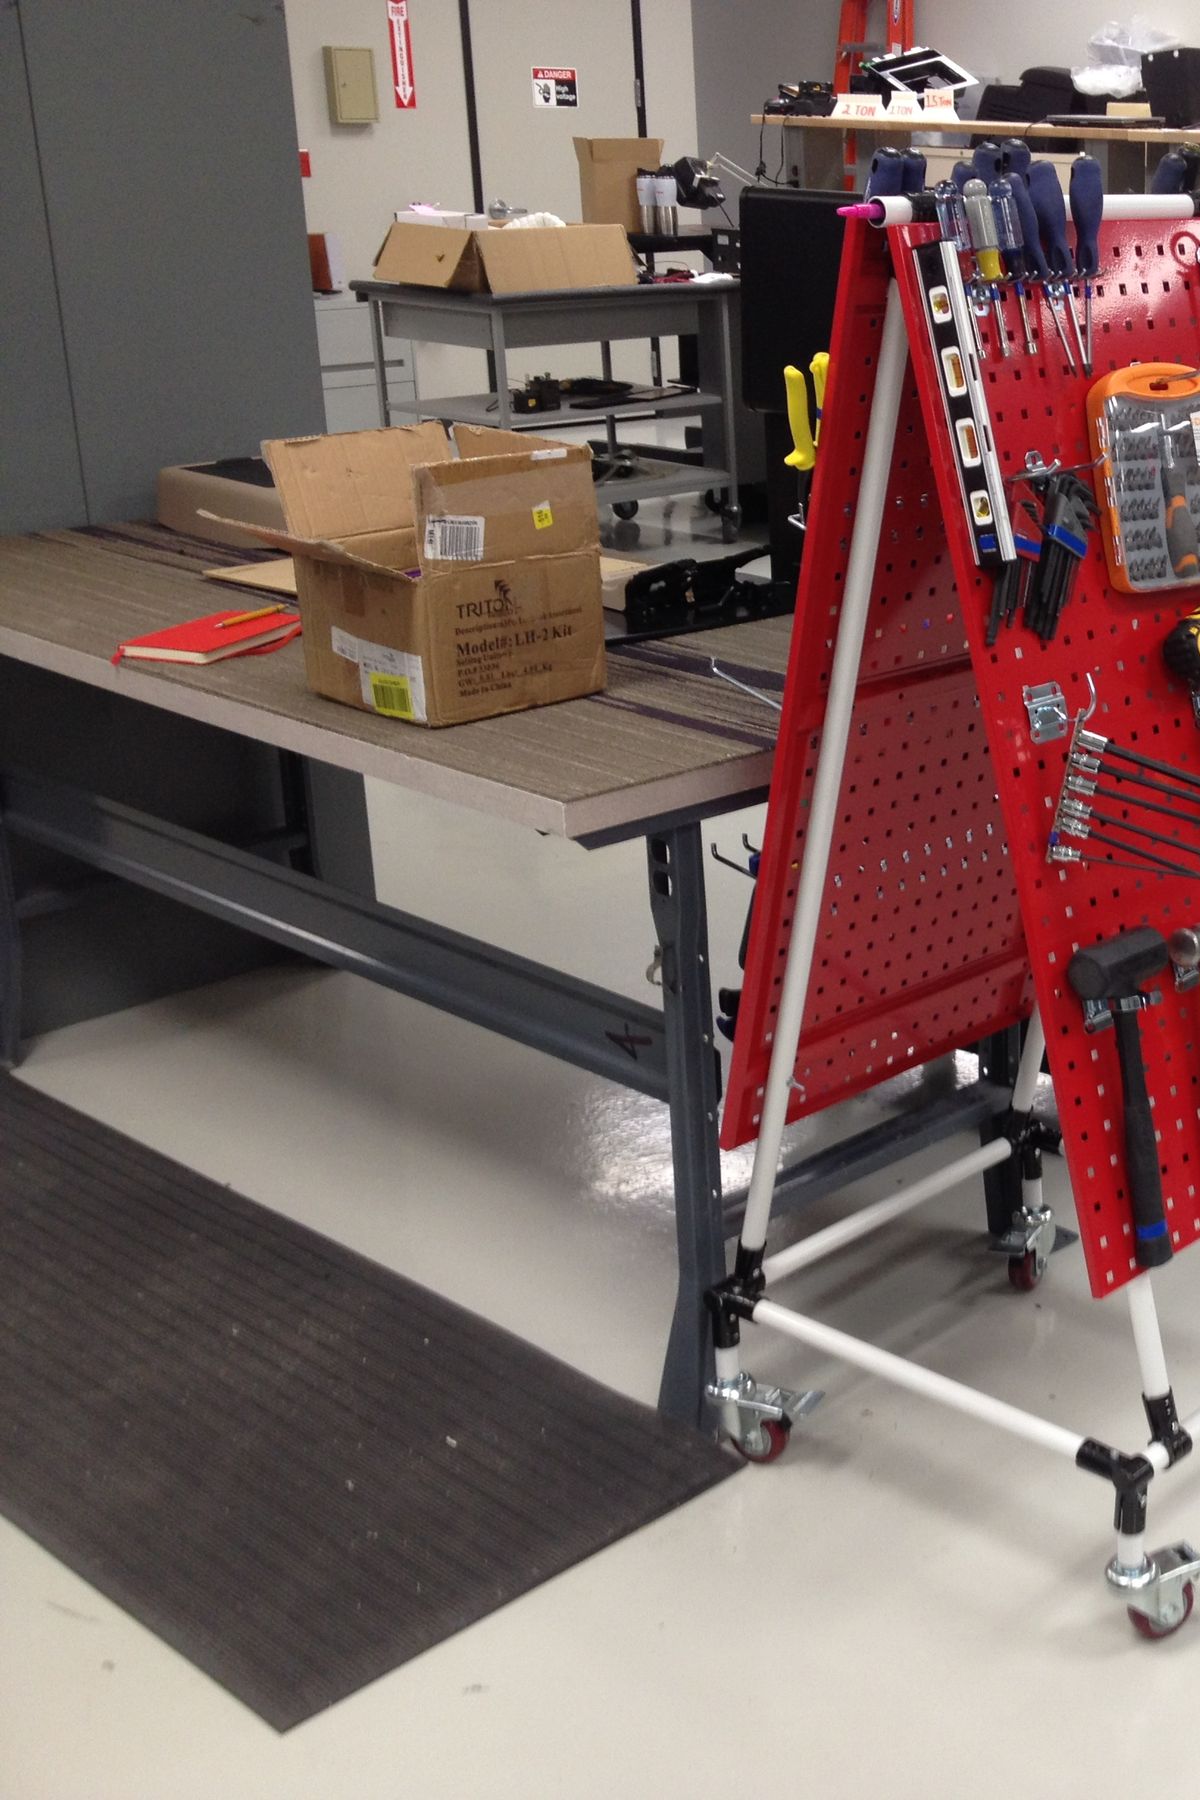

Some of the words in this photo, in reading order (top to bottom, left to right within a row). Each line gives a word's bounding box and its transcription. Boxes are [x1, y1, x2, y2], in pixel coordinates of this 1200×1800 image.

[543, 70, 572, 79] DANGER
[842, 104, 851, 115] 2
[855, 105, 877, 117] TON
[889, 105, 896, 115] 1
[896, 105, 913, 116] TON
[456, 636, 513, 657] Model#:
[515, 628, 549, 647] LH-2
[552, 624, 573, 639] Kit
